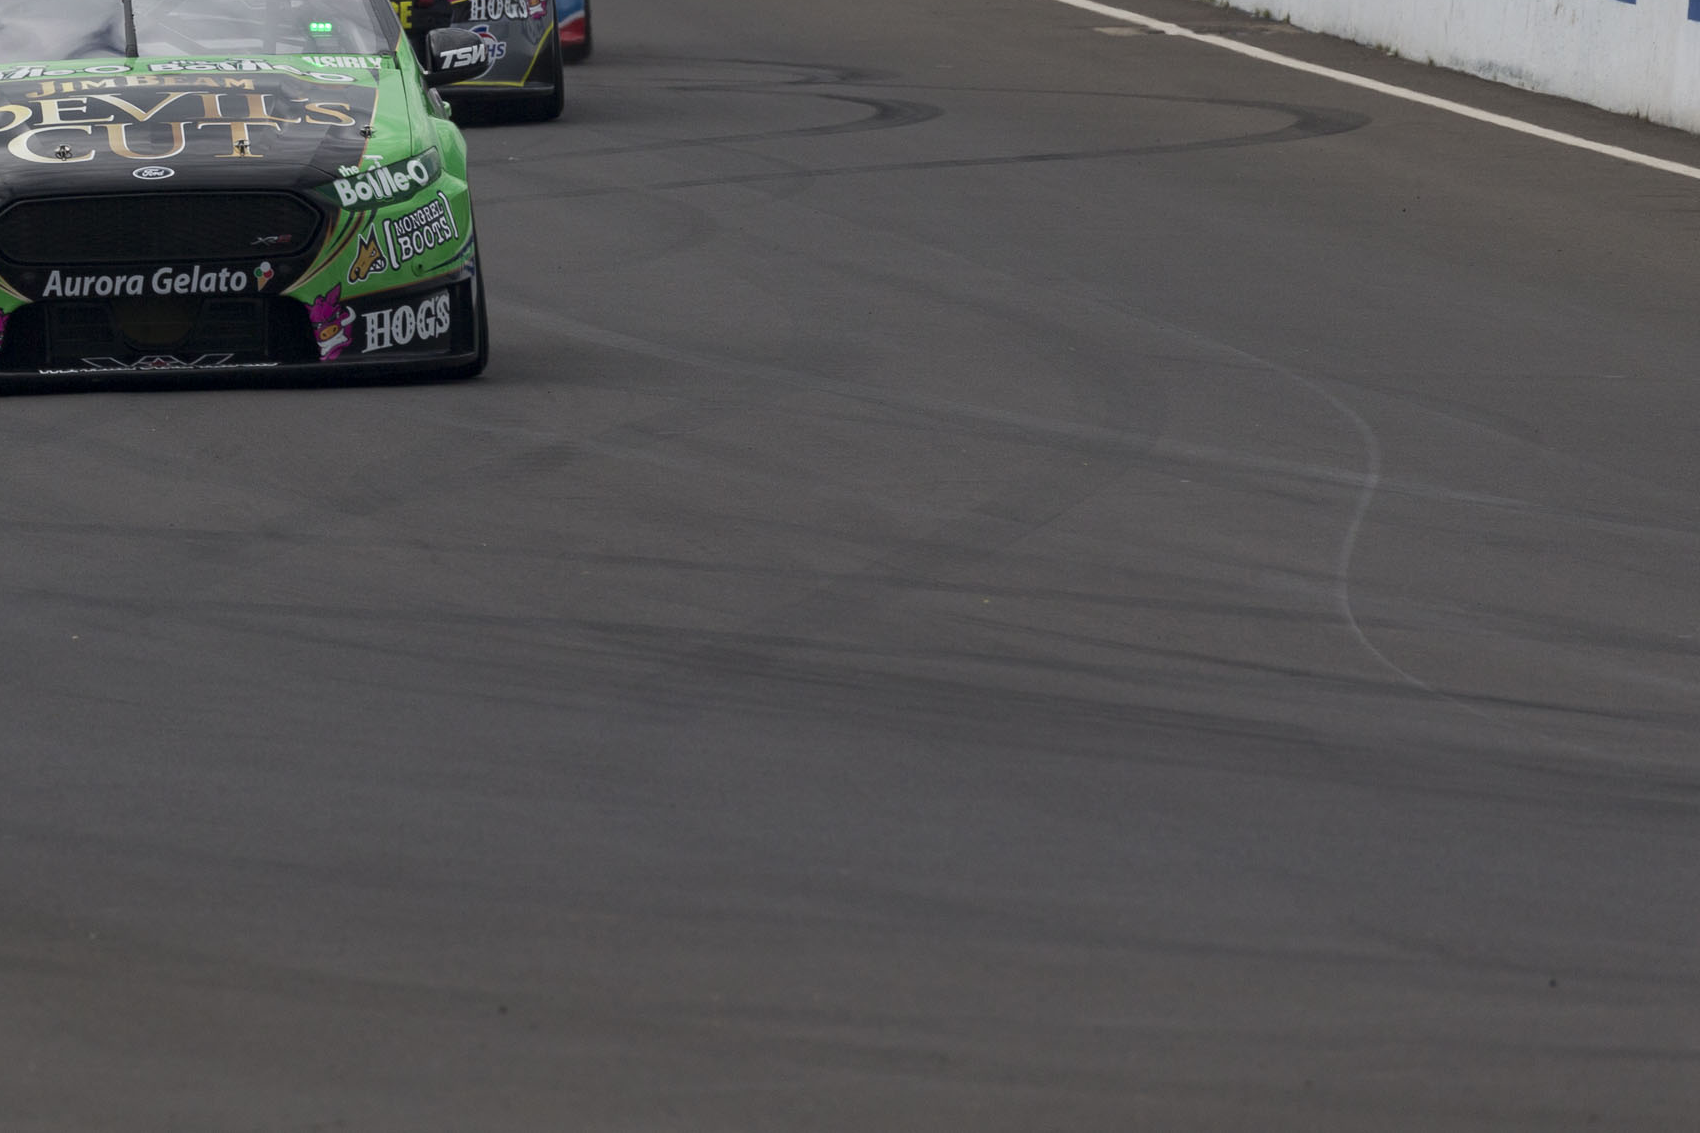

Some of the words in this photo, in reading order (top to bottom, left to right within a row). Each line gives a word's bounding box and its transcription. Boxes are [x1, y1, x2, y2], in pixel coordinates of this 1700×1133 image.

[440, 44, 490, 69] TSW
[26, 78, 115, 98] JIM
[120, 74, 256, 91] BEAM
[7, 121, 282, 163] CUT
[141, 168, 165, 178] Ford
[333, 155, 430, 207] Bottle-O
[338, 165, 360, 178] the
[394, 199, 444, 237] MONGREL
[397, 217, 451, 261] BOOTS
[42, 269, 145, 297] Aurora
[151, 265, 248, 295] Gelato
